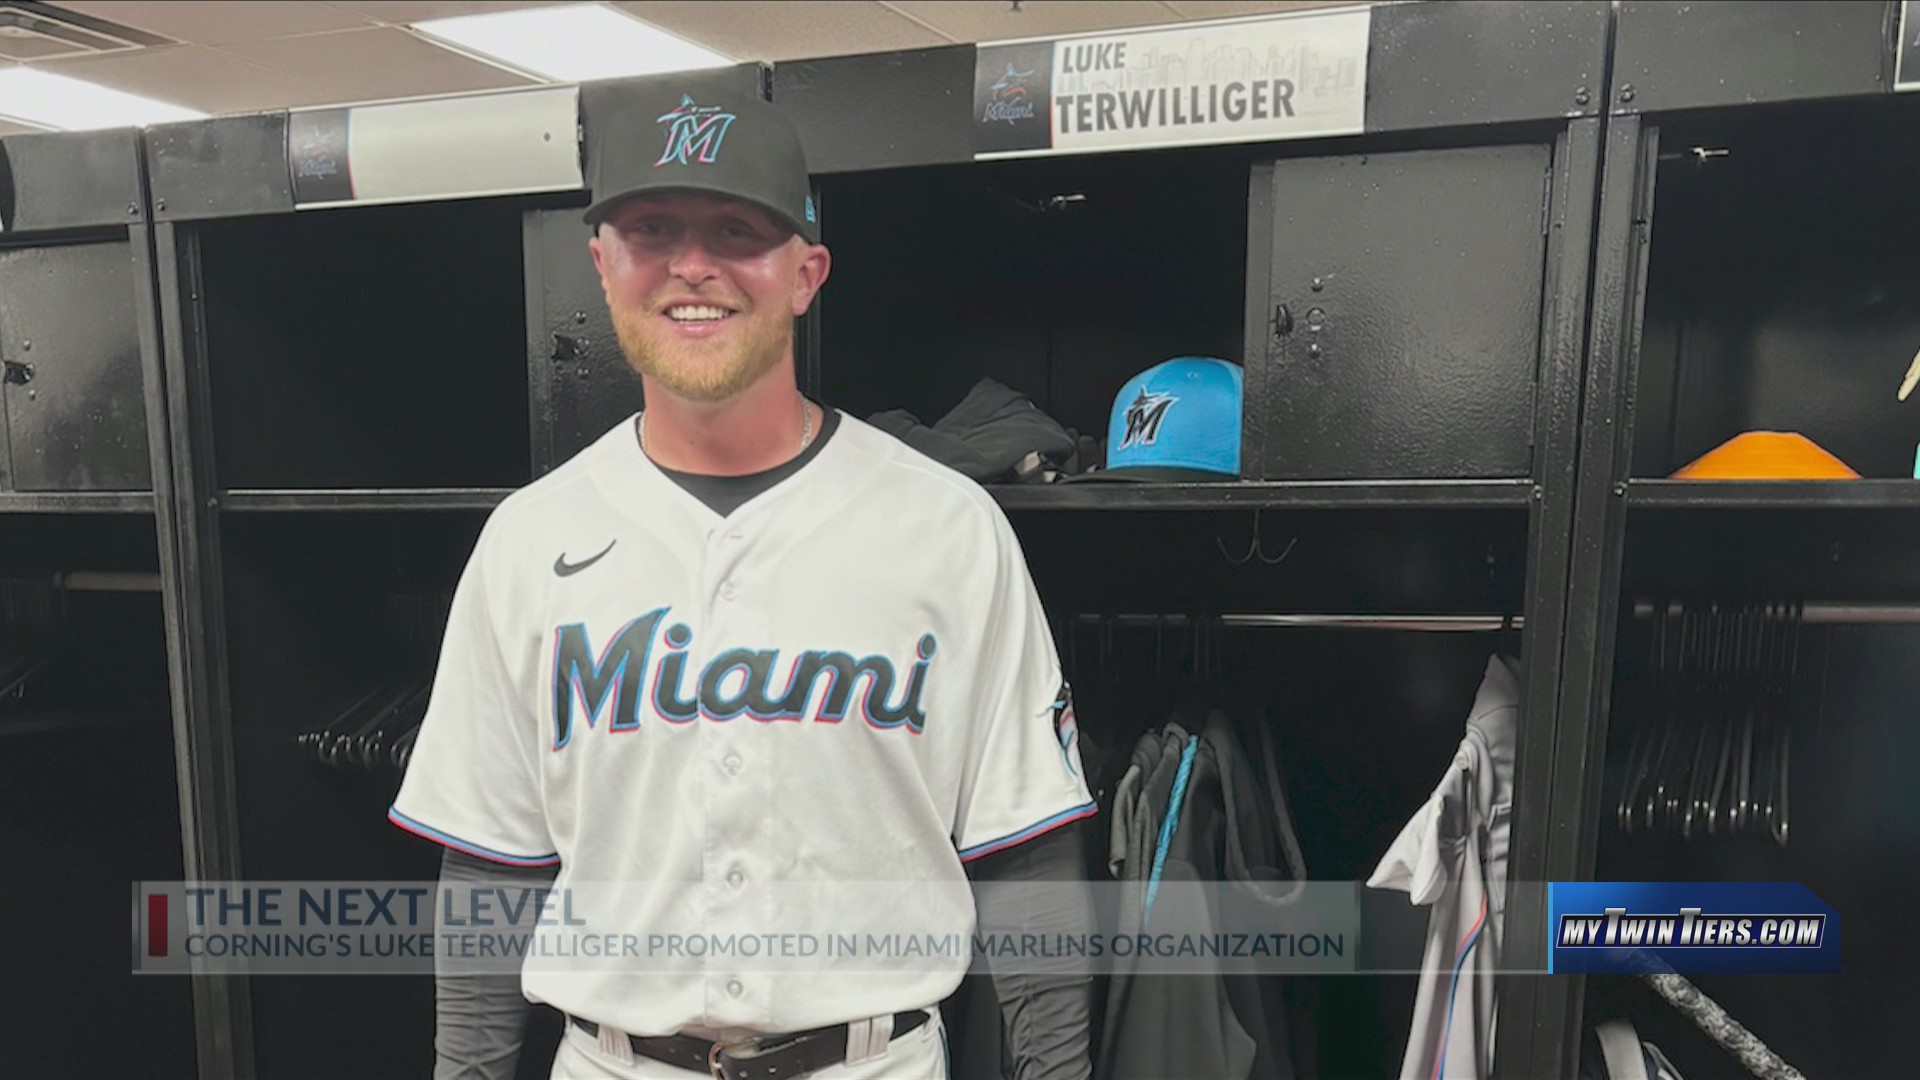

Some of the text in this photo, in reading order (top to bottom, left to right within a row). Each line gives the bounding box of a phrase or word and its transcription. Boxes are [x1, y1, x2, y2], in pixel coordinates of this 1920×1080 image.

[1062, 42, 1127, 74] LUKE
[1056, 79, 1294, 134] TERWILLIGER
[552, 606, 937, 752] Miami
